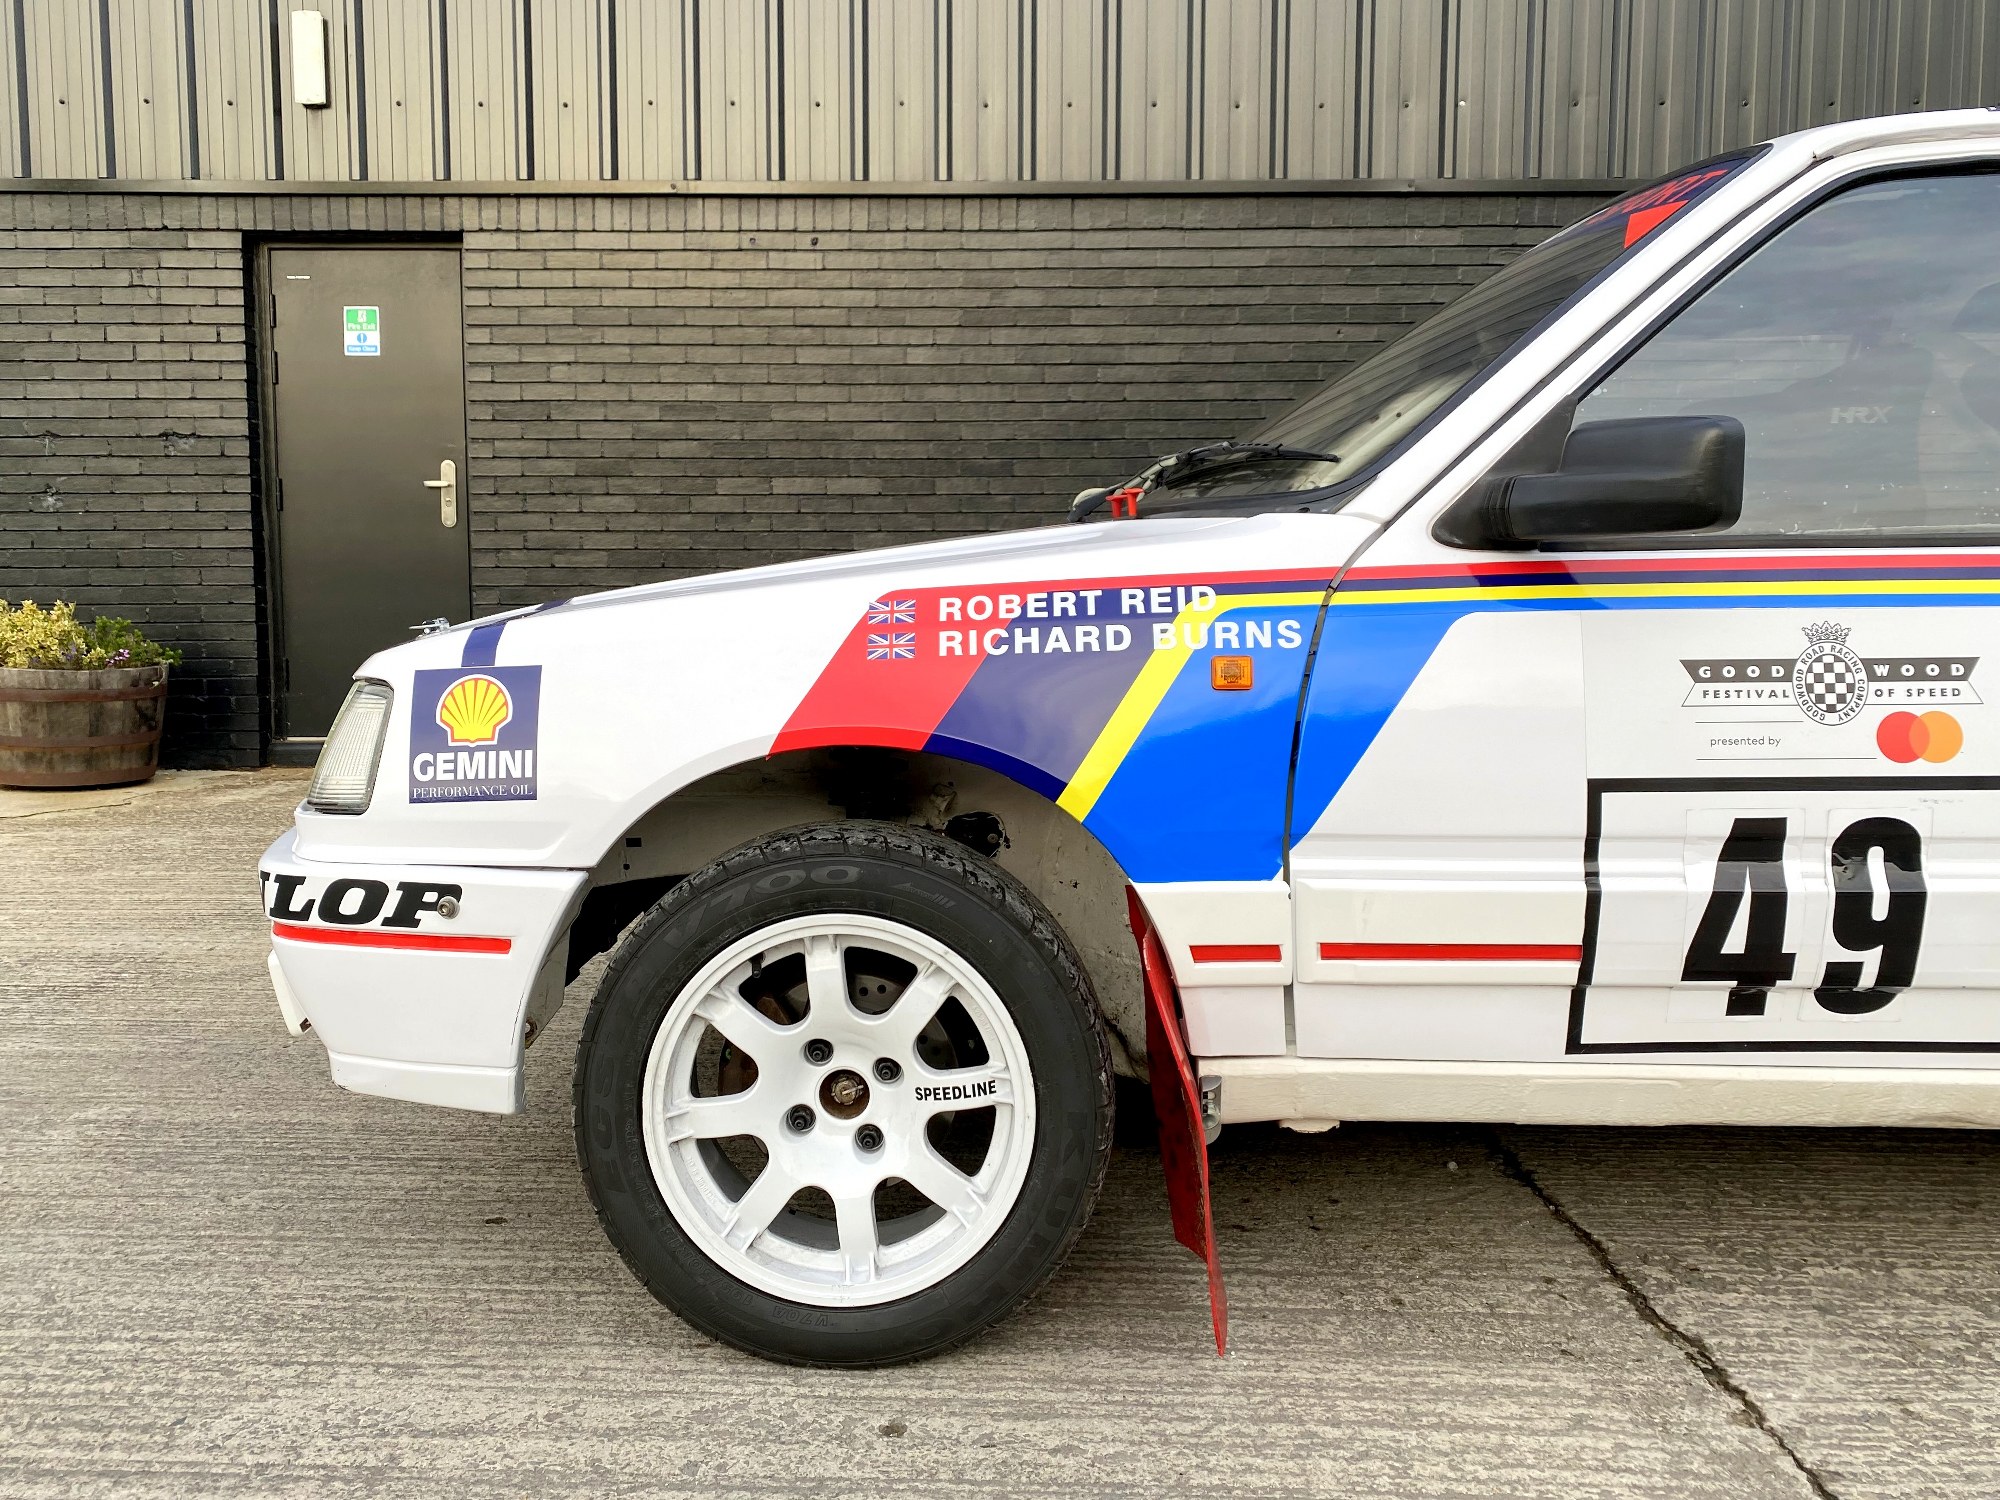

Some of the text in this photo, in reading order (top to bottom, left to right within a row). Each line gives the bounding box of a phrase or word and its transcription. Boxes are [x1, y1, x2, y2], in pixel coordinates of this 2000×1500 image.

[1831, 406, 1893, 424] HRX
[939, 586, 1218, 622] ROBERT REID
[938, 620, 1303, 657] RICHARD BURNS
[1698, 663, 1966, 679] GOOD WOOD
[1795, 644, 1866, 722] GOODWOOD ROAD RACING COMPANY
[1702, 687, 1962, 699] FESTIVAL OF SPEED
[1710, 735, 1782, 748] presented by
[412, 749, 534, 783] GEMINI
[412, 783, 534, 799] PERFORMANCE OIL
[260, 870, 463, 929] LOP
[1681, 816, 1928, 1017] 49
[914, 1079, 997, 1102] SPEEDLINE
